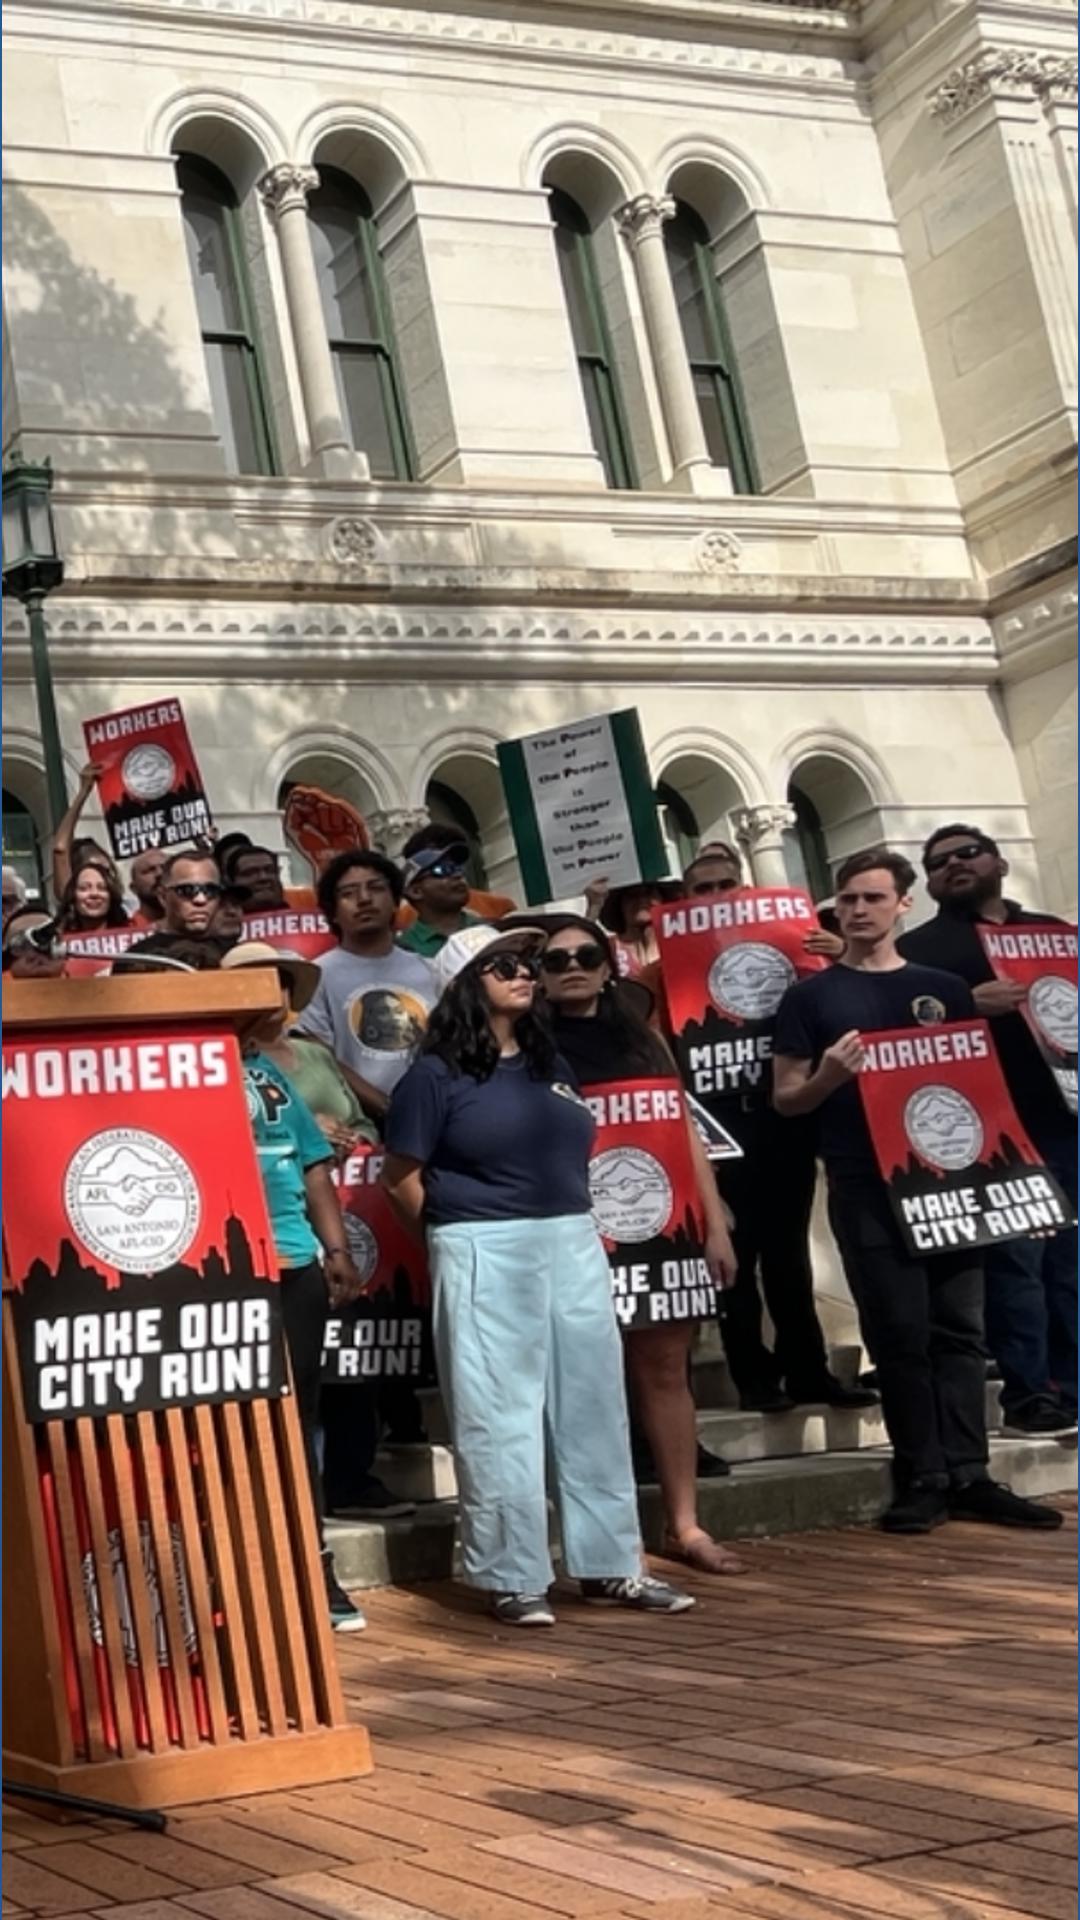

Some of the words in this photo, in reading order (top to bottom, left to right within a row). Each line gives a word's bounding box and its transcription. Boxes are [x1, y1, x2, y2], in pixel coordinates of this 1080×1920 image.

[88, 703, 181, 745] WORKERS
[532, 739, 556, 750] The
[561, 726, 603, 744] Power
[564, 747, 577, 759] of
[538, 773, 560, 784] the
[563, 760, 610, 778] People
[572, 787, 584, 797] is
[113, 810, 166, 840] MAKE
[171, 798, 207, 821] OUR
[553, 799, 610, 819] Stronger
[118, 830, 160, 857] CITY
[166, 816, 211, 844] RUN!
[569, 820, 600, 832] than
[552, 844, 575, 855] the
[577, 832, 624, 850] People
[562, 862, 576, 871] in
[578, 851, 621, 869] Power
[662, 896, 813, 938] WORKERS
[689, 1035, 774, 1071] MAKE
[862, 1030, 988, 1073] WORKERS
[2, 1041, 228, 1099] WORKERS
[694, 1061, 763, 1094] CITY
[901, 1187, 982, 1224] MAKE
[985, 1174, 1053, 1209] OUR
[96, 1222, 121, 1236] SAN
[124, 1218, 180, 1234] ANTONIO
[911, 1215, 977, 1250] CITY
[983, 1199, 1066, 1236] RUN!
[661, 1257, 712, 1289] OUR
[649, 1286, 717, 1321] RUN!
[34, 1308, 162, 1364] MAKE
[180, 1299, 270, 1350] OUR
[353, 1318, 422, 1347] OUR
[39, 1356, 143, 1412] CITY
[160, 1345, 271, 1400] RUN!
[338, 1348, 421, 1377] RUN!
